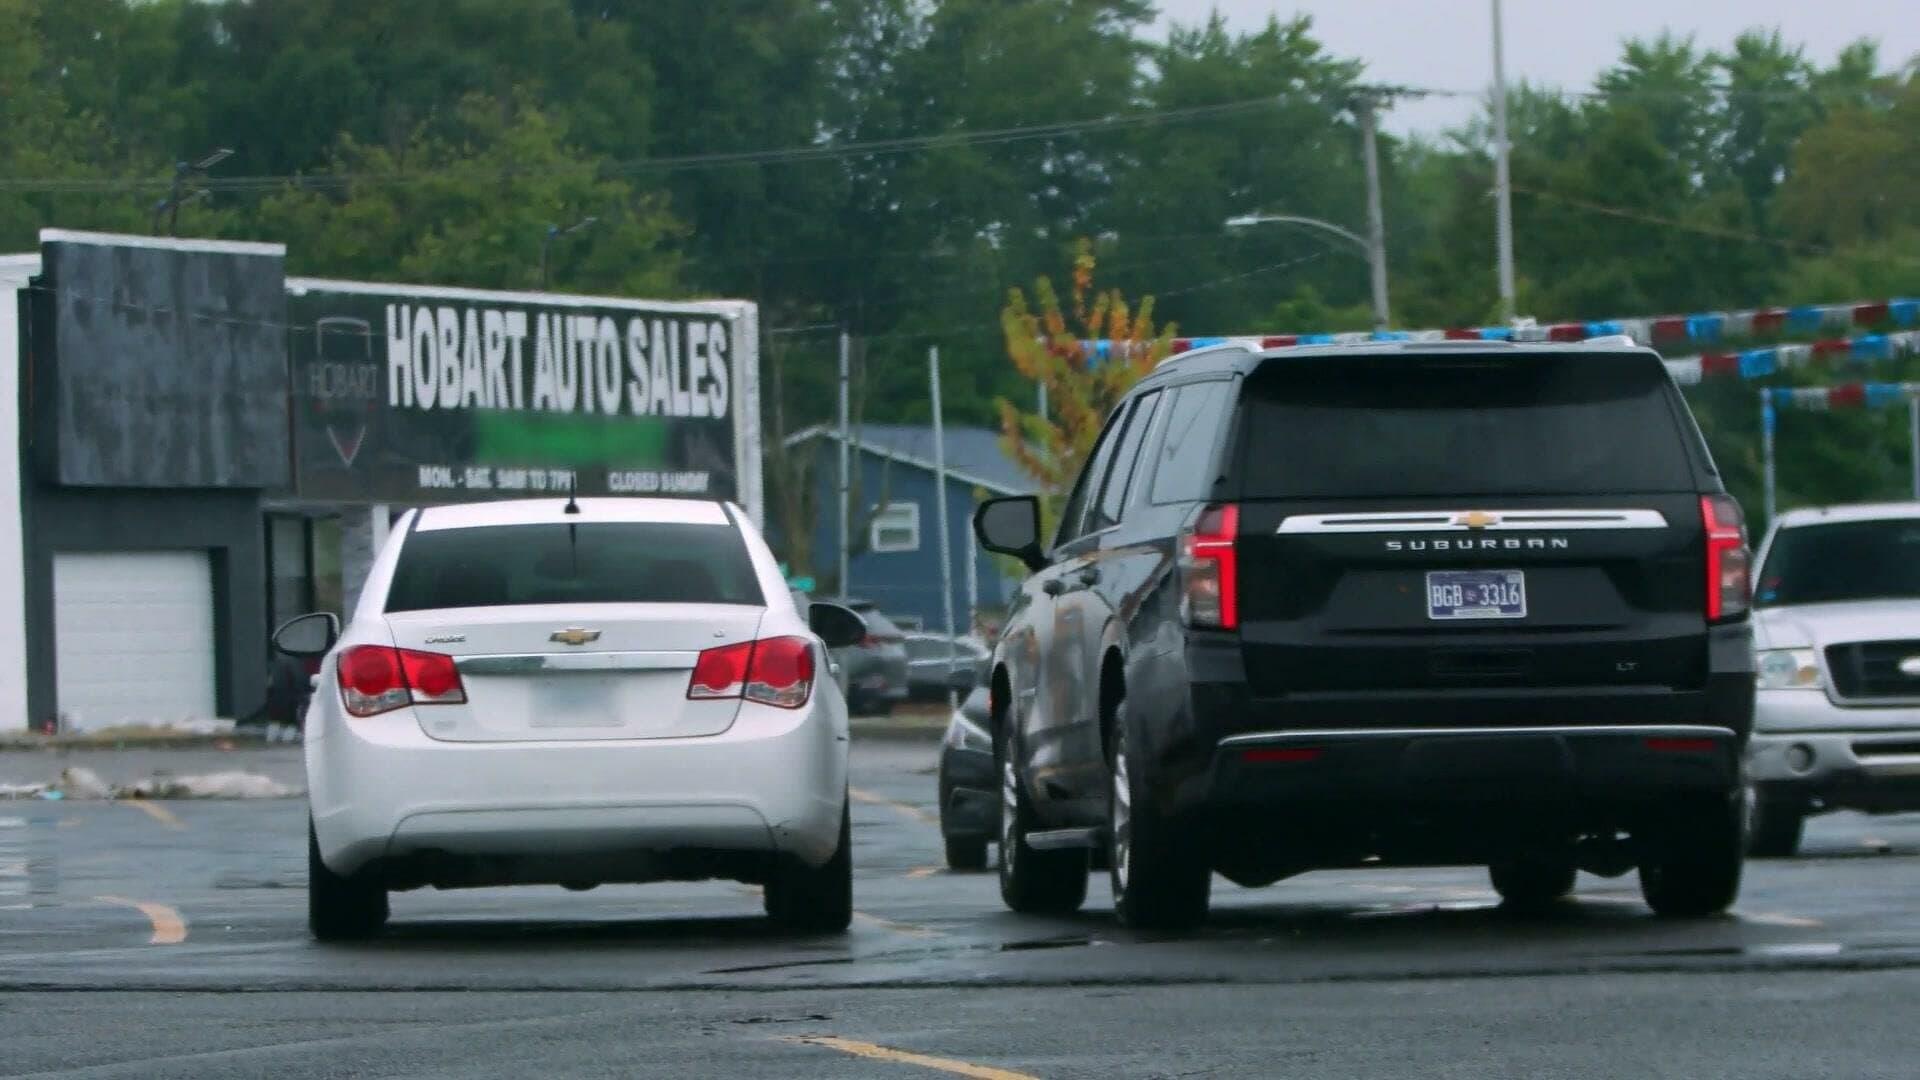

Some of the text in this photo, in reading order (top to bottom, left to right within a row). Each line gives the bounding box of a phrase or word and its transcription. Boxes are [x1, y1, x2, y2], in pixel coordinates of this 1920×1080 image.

[386, 304, 729, 418] HOBART AUTO SALES
[310, 363, 377, 398] HOBART
[608, 471, 658, 491] CLOSED
[1386, 538, 1569, 551] SUBURBAN
[1432, 583, 1519, 607] BGB 3316
